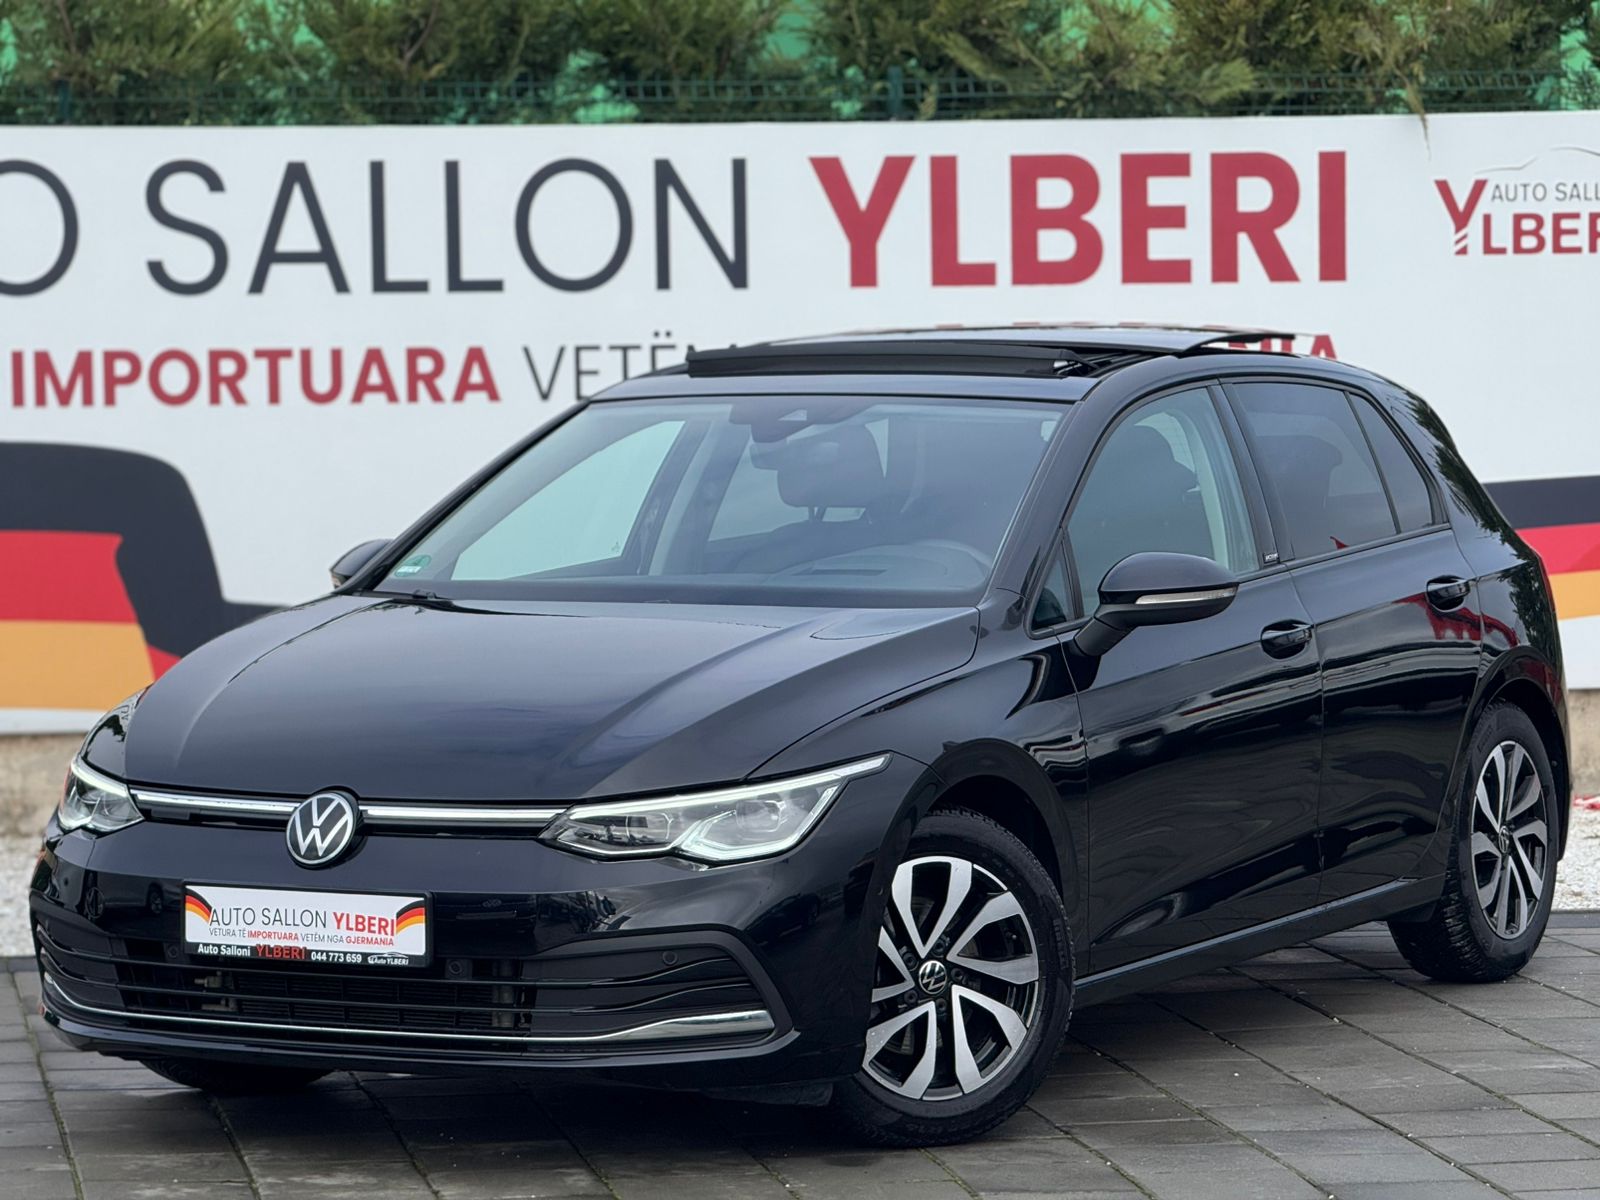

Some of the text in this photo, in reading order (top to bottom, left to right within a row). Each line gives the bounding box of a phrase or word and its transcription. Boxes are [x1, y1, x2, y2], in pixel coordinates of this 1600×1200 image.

[1490, 182, 1548, 202] AUTO
[145, 158, 749, 297] SALLON
[808, 150, 1348, 288] YLBERI
[12, 347, 502, 408] IMPORTUARA
[209, 907, 395, 936] AUTO SALLON YLBERI
[209, 927, 237, 937] VETURA
[247, 930, 299, 941] IMPORTUARA
[301, 932, 325, 943] VETËM
[327, 935, 344, 943] NGA
[345, 935, 394, 946] GJERMANIA
[197, 943, 219, 954] Auto
[220, 945, 251, 957] Salloni
[256, 943, 307, 959] YLBERI
[311, 951, 326, 961] 044
[328, 952, 344, 962] 773
[346, 953, 362, 963] 659
